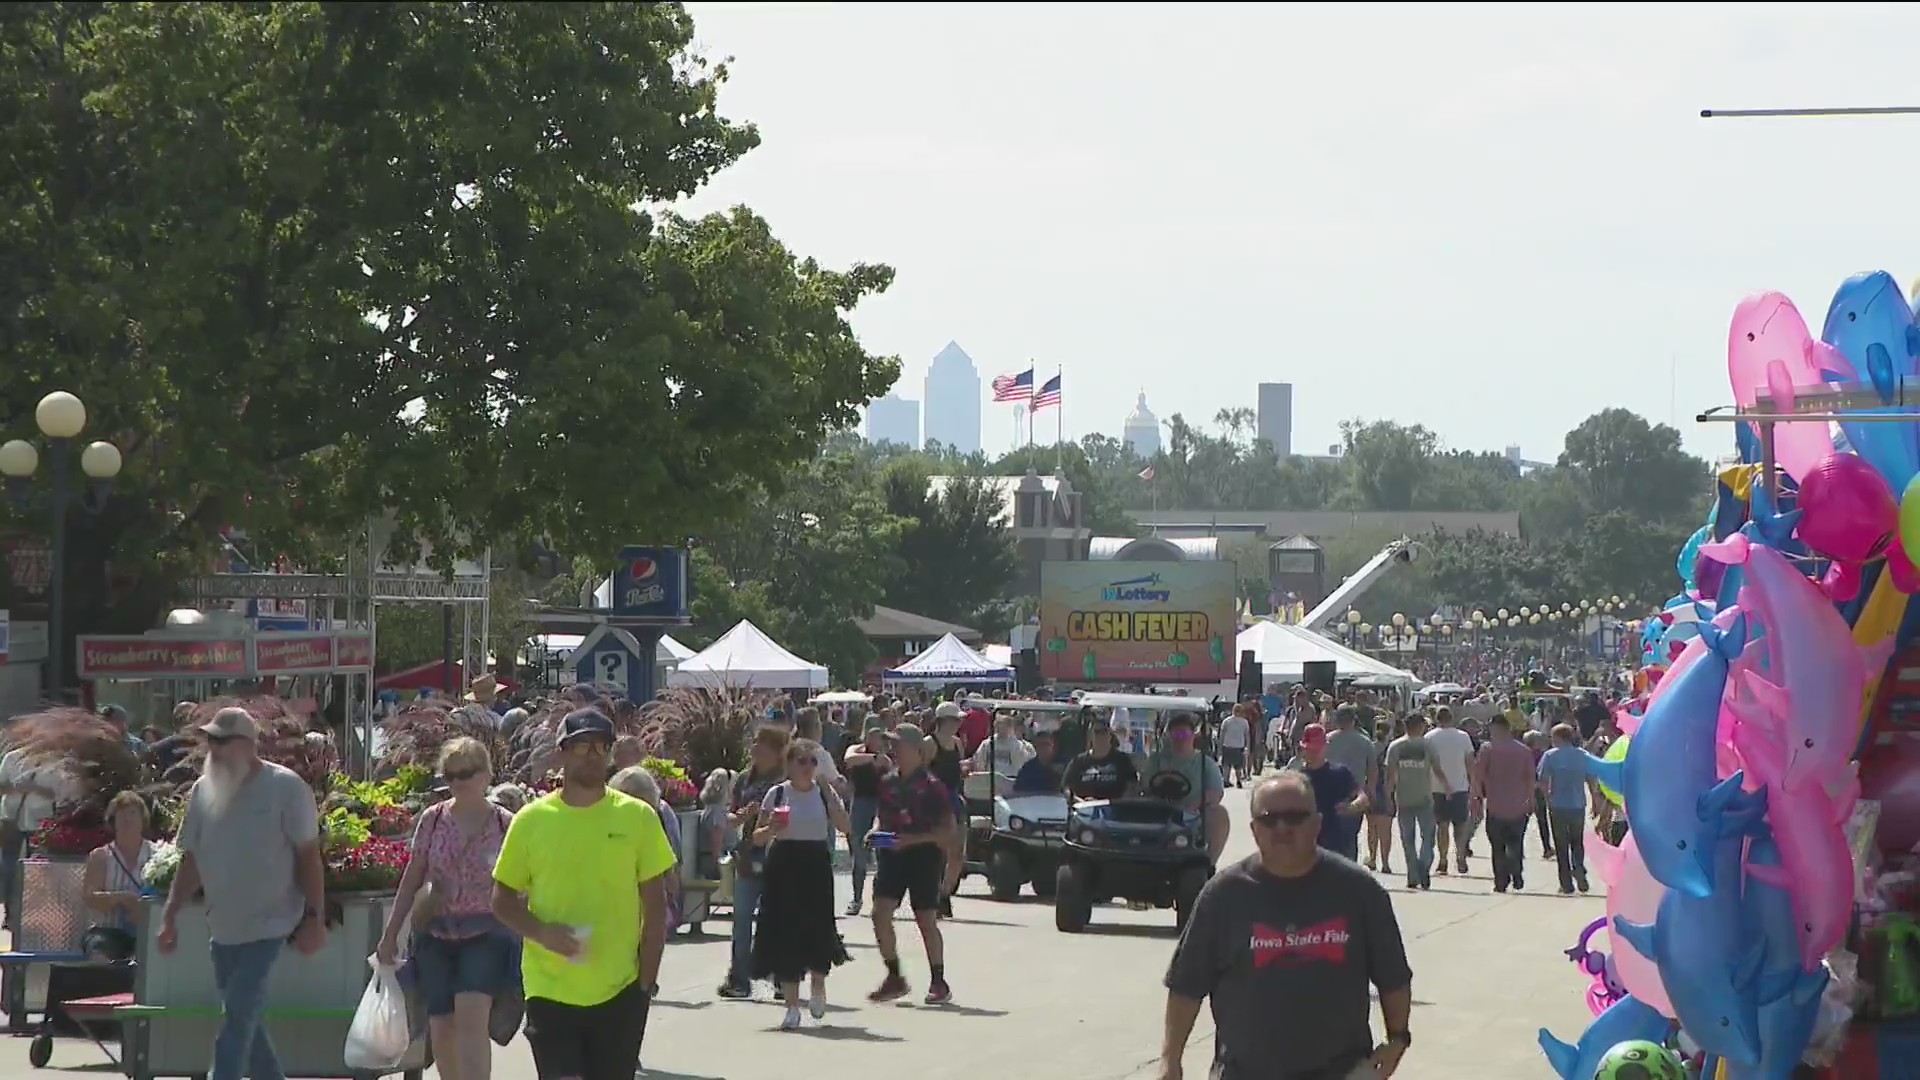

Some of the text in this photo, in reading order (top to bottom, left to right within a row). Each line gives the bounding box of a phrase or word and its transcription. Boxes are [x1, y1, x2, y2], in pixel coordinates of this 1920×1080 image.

[1068, 611, 1209, 641] CASH FEVER
[87, 646, 242, 666] Strawberry Smoothies
[259, 642, 311, 658] Strawberry
[1249, 929, 1350, 949] Iowa State Fair
